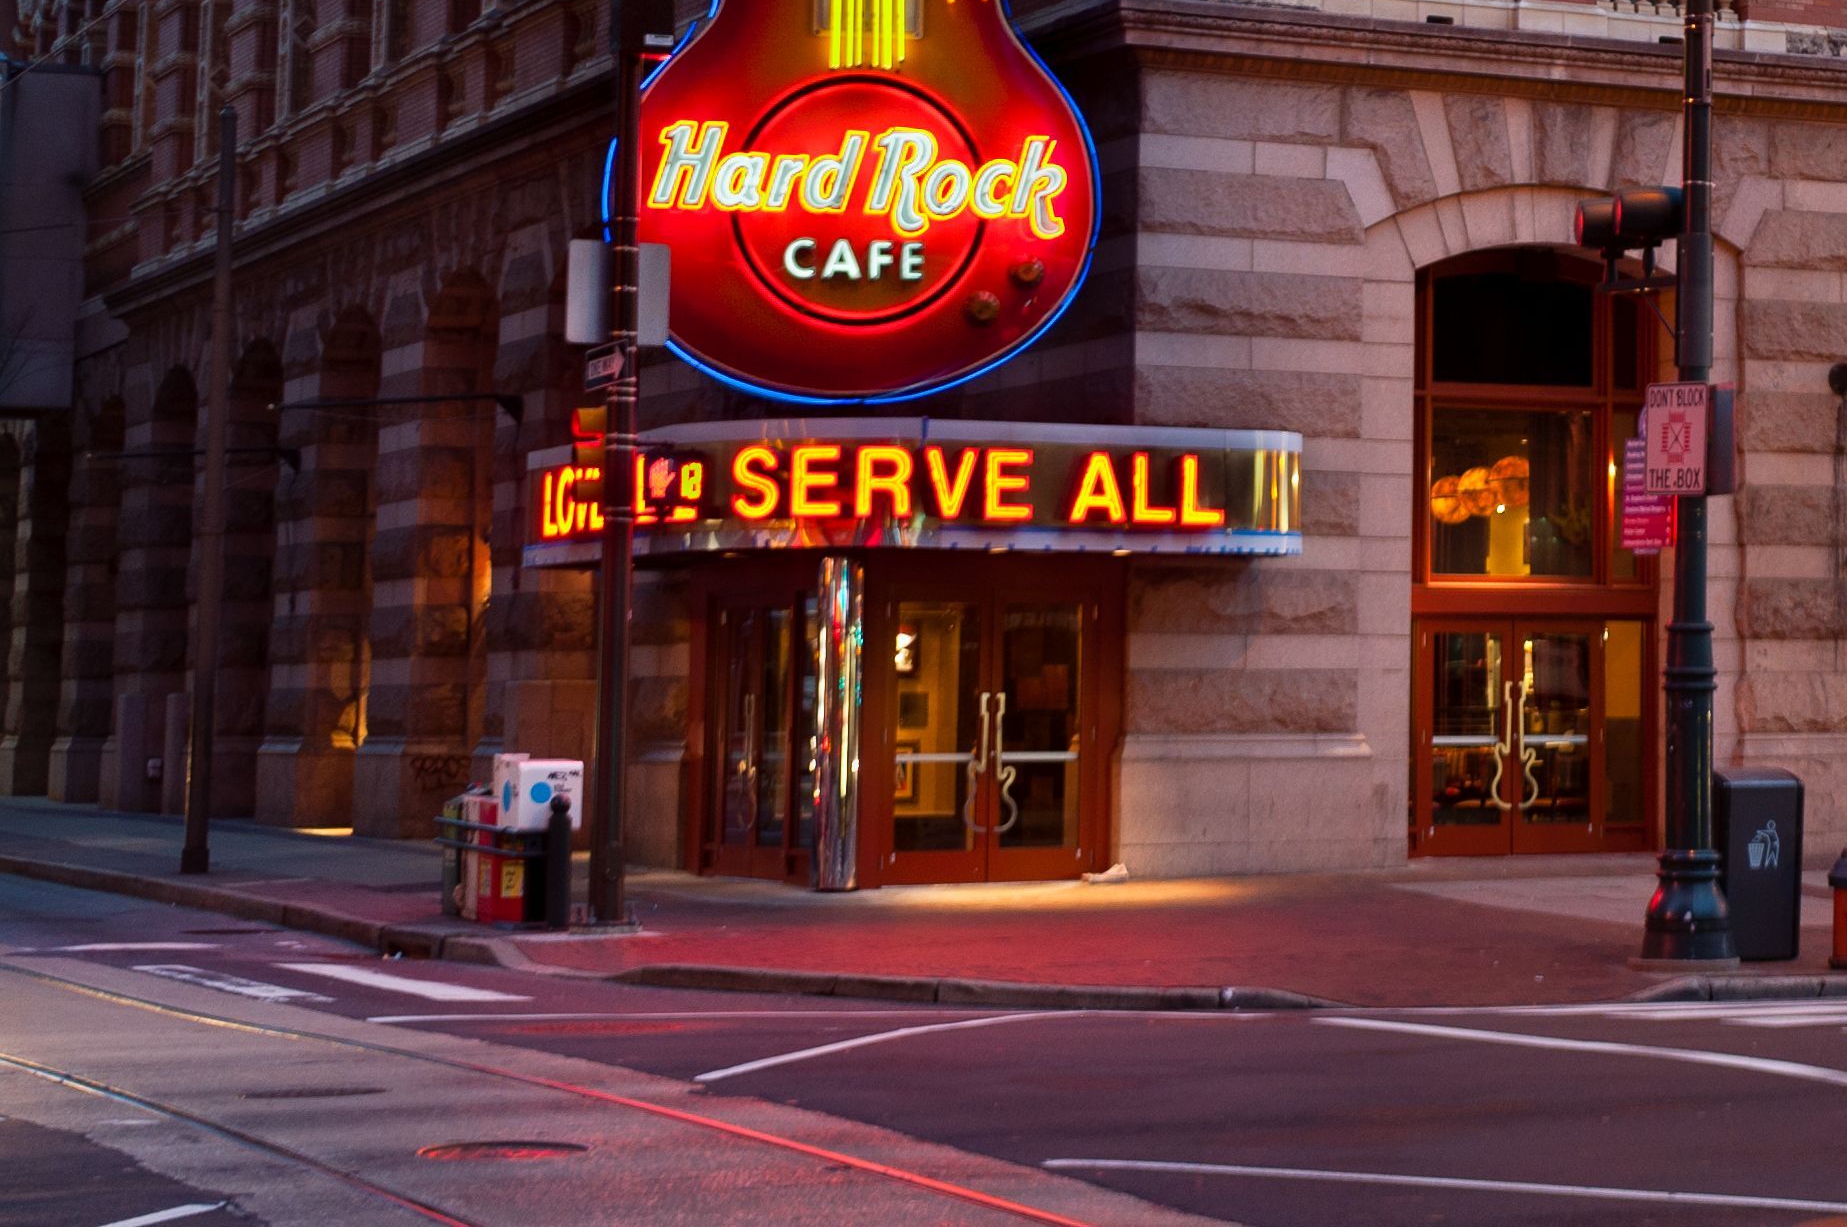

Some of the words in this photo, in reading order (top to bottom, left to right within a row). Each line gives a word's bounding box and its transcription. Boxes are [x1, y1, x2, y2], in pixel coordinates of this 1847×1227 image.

[649, 120, 868, 212] Hard
[866, 126, 1067, 241] Rock
[783, 237, 925, 282] CAFE
[1676, 387, 1705, 407] BLOCK
[731, 444, 1034, 521] SERVE
[1069, 451, 1225, 527] ALL
[1649, 469, 1671, 488] THE
[1677, 468, 1701, 488] BOX
